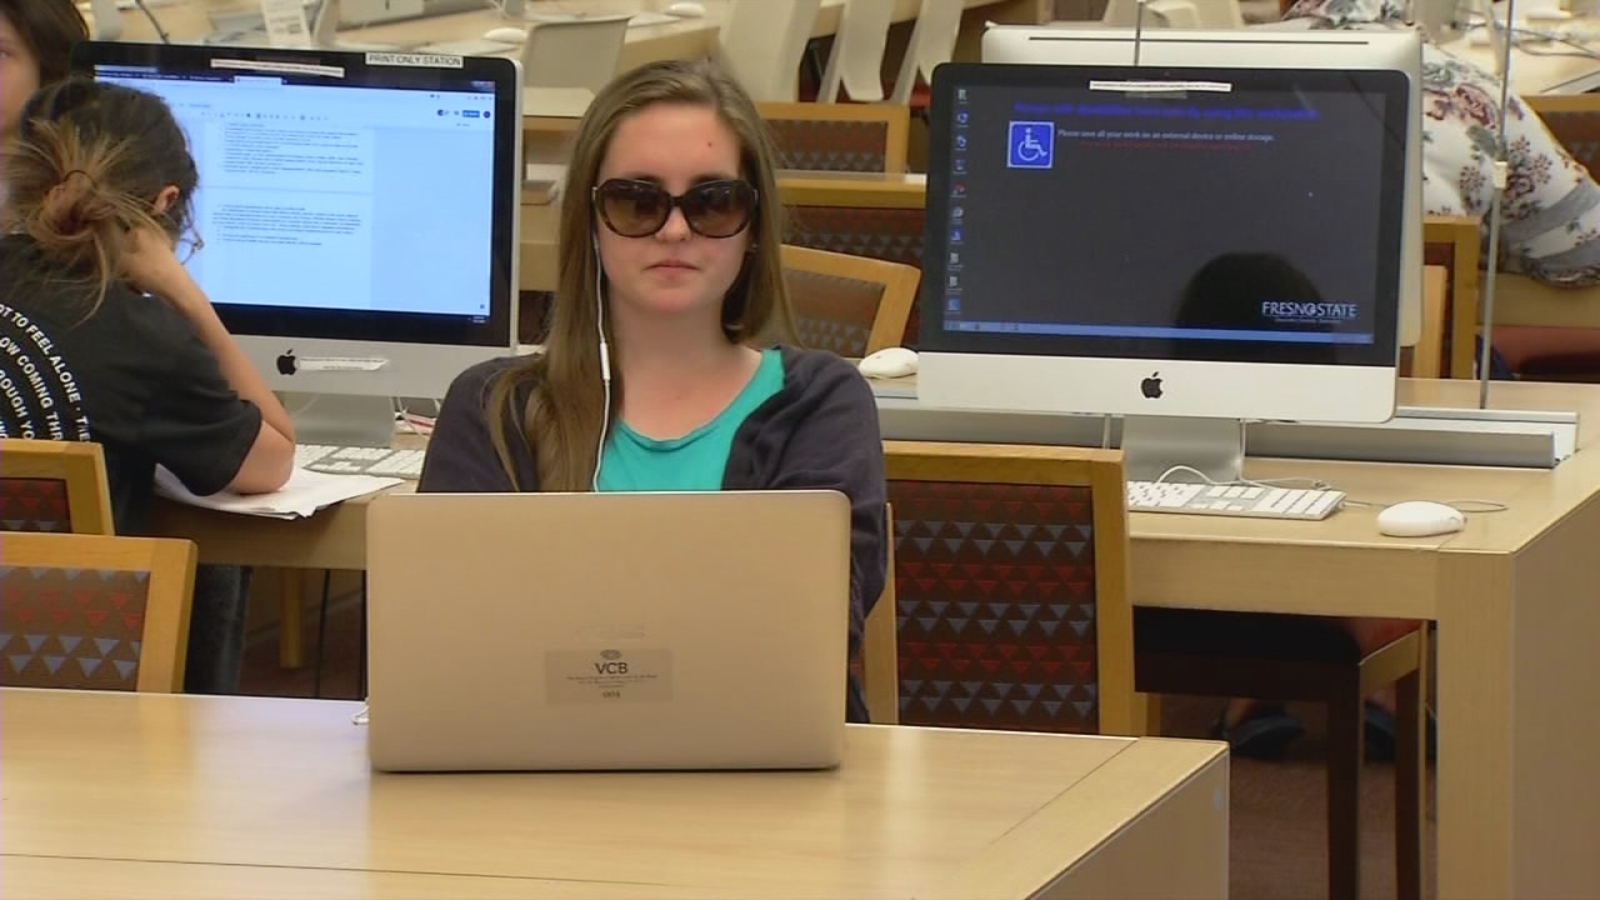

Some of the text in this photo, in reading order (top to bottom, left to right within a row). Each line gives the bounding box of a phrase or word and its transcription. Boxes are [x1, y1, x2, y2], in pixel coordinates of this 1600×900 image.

[368, 54, 461, 66] PRINT ONLY STATION
[11, 311, 29, 327] TO
[25, 324, 54, 355] FEEL
[50, 355, 82, 403] ALONE
[17, 355, 54, 409] COMING
[594, 662, 629, 675] VCB
